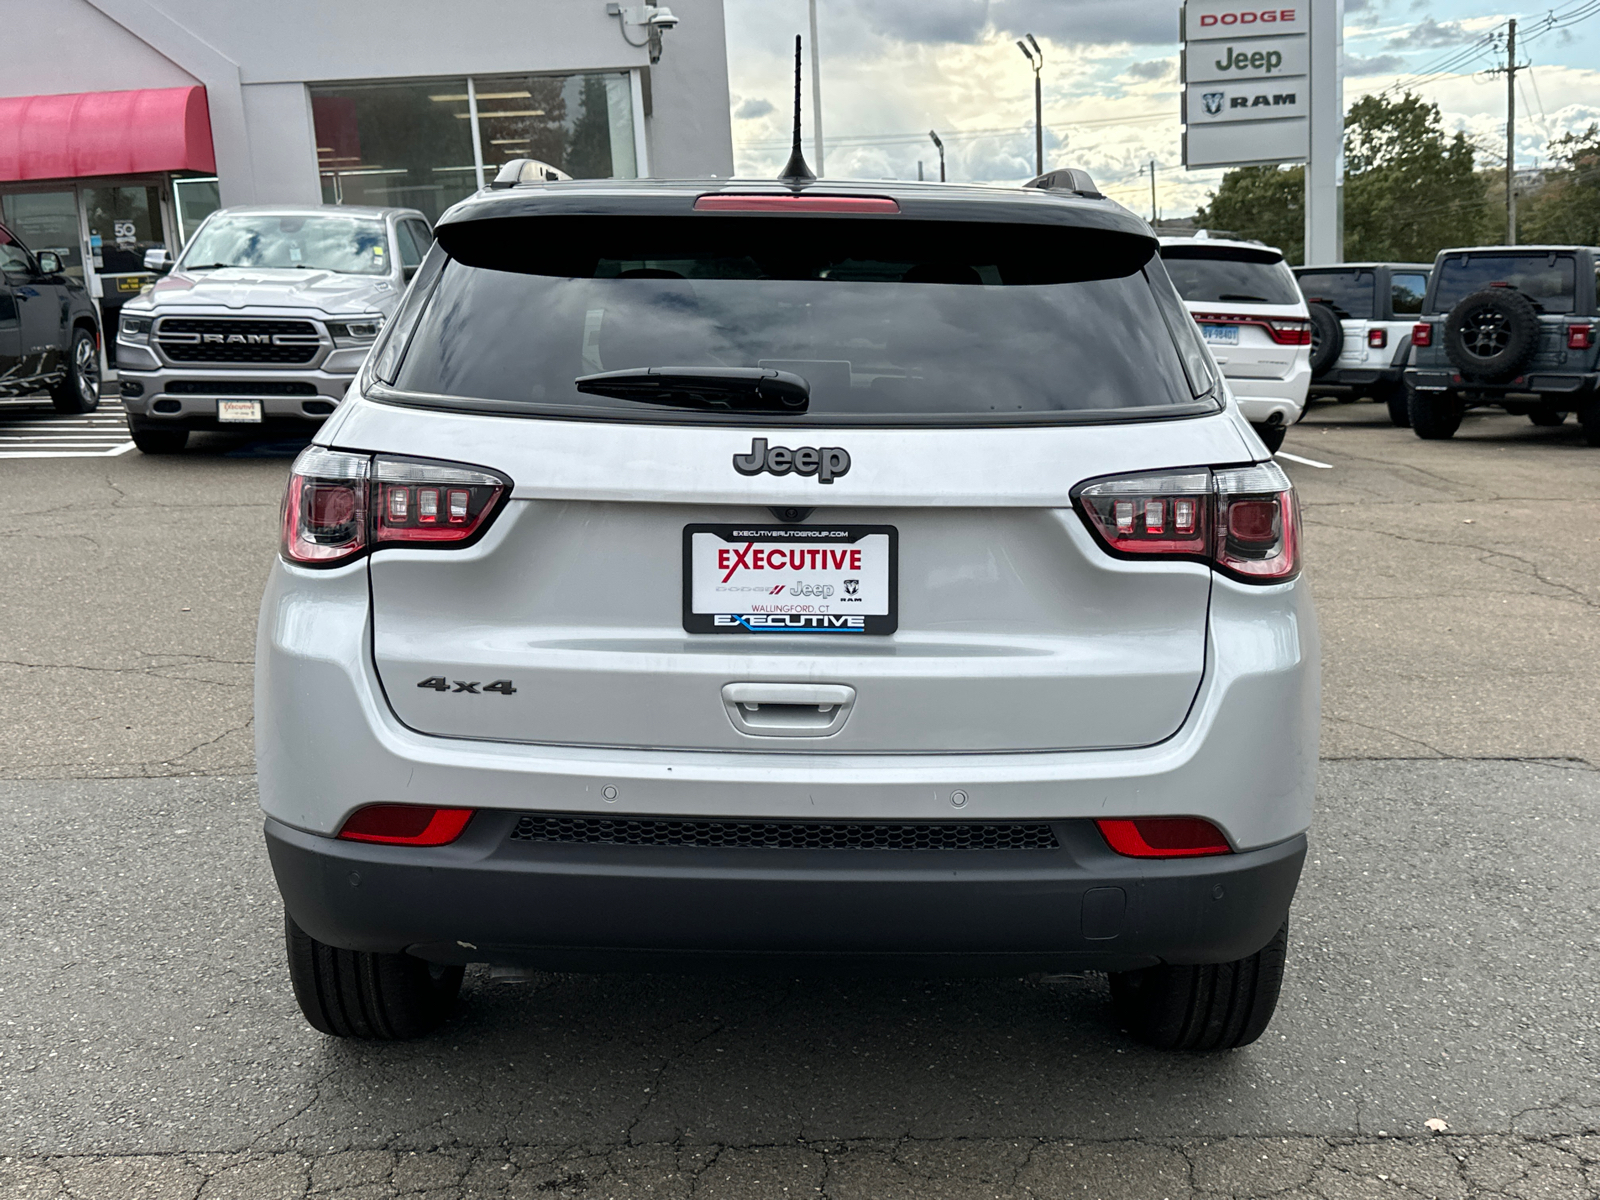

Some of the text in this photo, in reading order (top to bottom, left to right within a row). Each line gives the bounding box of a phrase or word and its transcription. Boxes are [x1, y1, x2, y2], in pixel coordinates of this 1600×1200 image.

[1200, 9, 1296, 27] DODGE
[1215, 46, 1282, 73] Jeep
[1229, 93, 1296, 109] RAM
[114, 223, 136, 237] 50
[203, 333, 270, 344] RAM
[733, 437, 851, 484] Jeep
[732, 530, 849, 538] EXECUTIVEAUTOGROUP.COM
[718, 542, 862, 582] EXECUTIVE
[789, 580, 835, 600] Jeep
[751, 604, 830, 614] WALLINGFORD, CT
[714, 614, 865, 628] EXECUTIVE
[417, 675, 517, 695] 4x4
